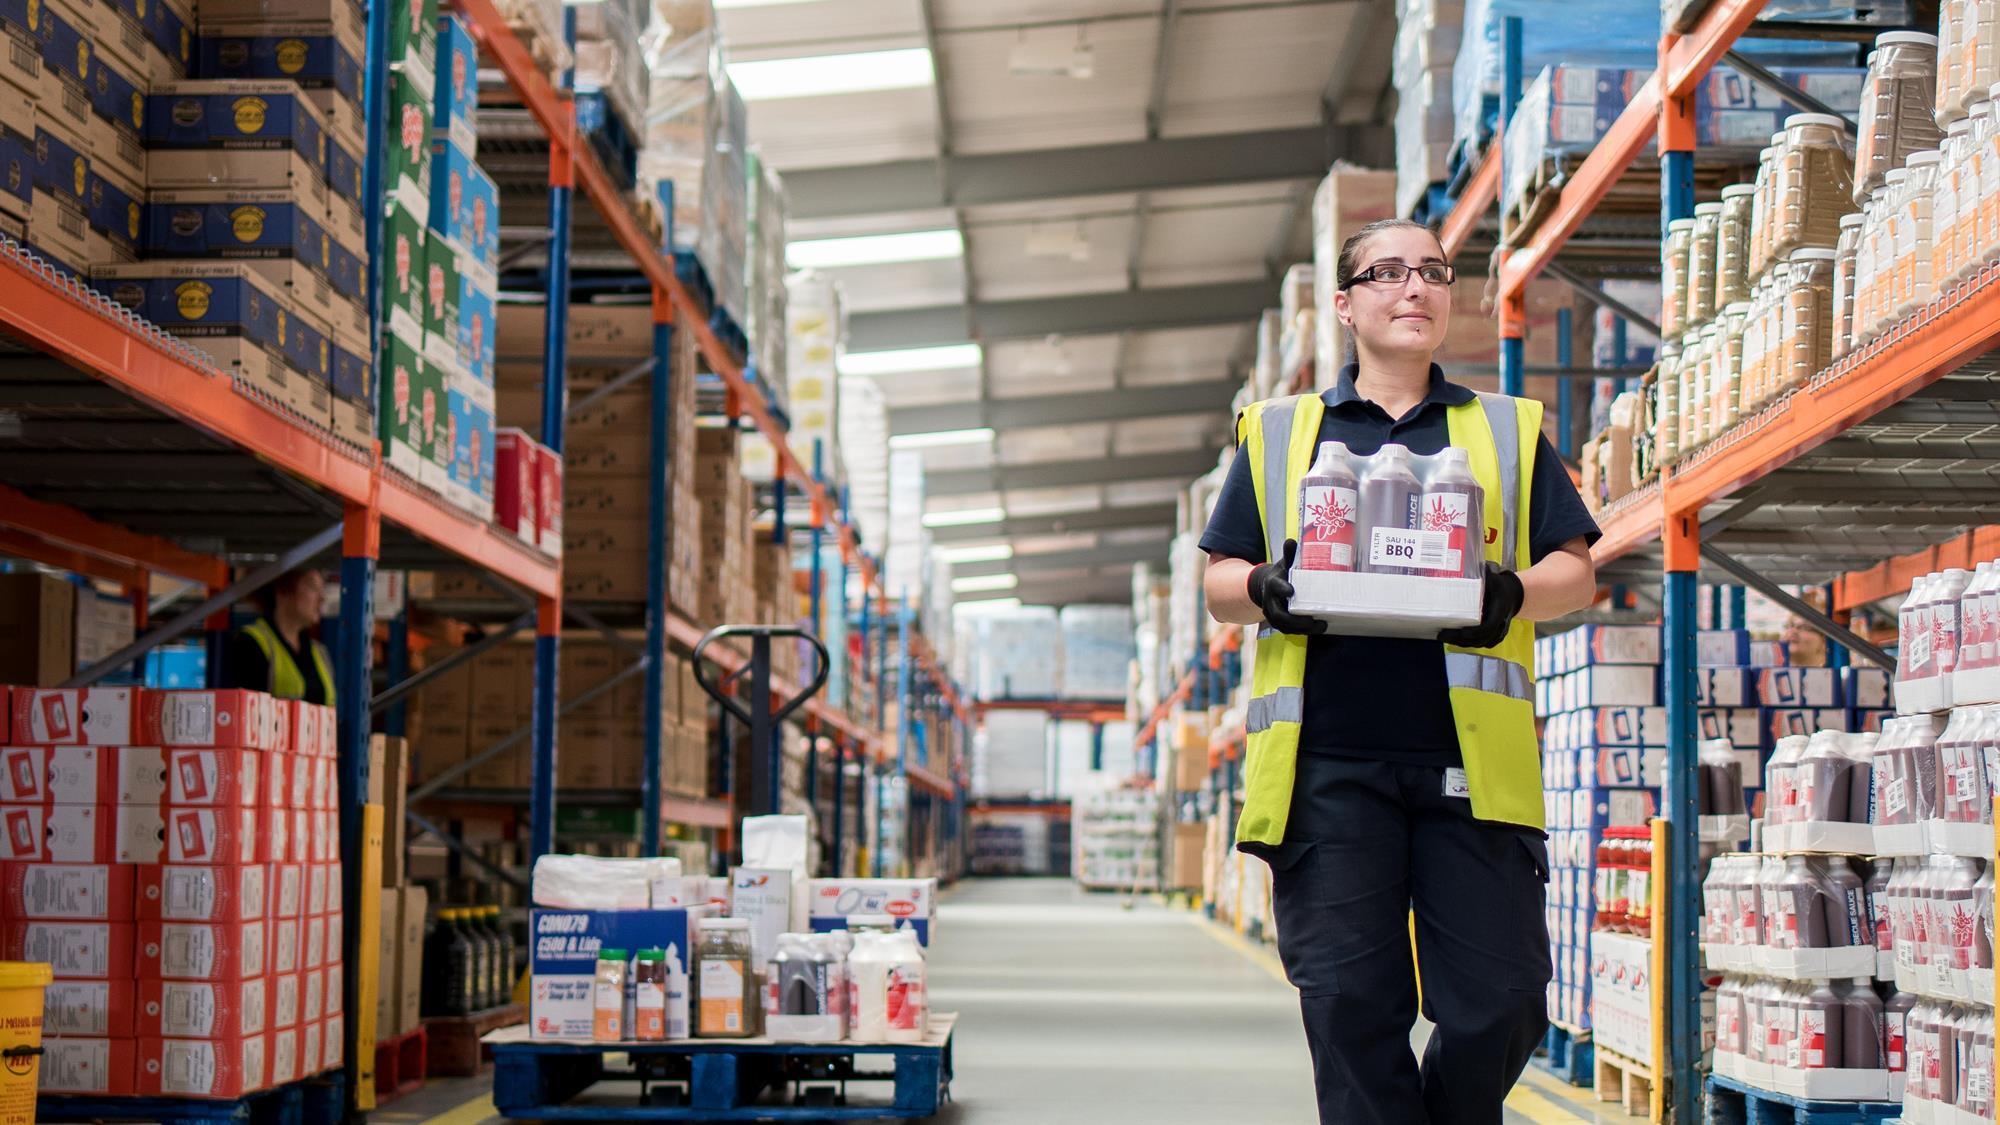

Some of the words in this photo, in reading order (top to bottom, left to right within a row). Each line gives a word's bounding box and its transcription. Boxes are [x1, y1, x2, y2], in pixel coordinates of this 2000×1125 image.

[1409, 494, 1418, 530] SAUCE
[1385, 536, 1401, 544] SAU
[1386, 544, 1414, 559] BBQ
[1847, 889, 1857, 917] SAUCE
[578, 936, 602, 951] Lids
